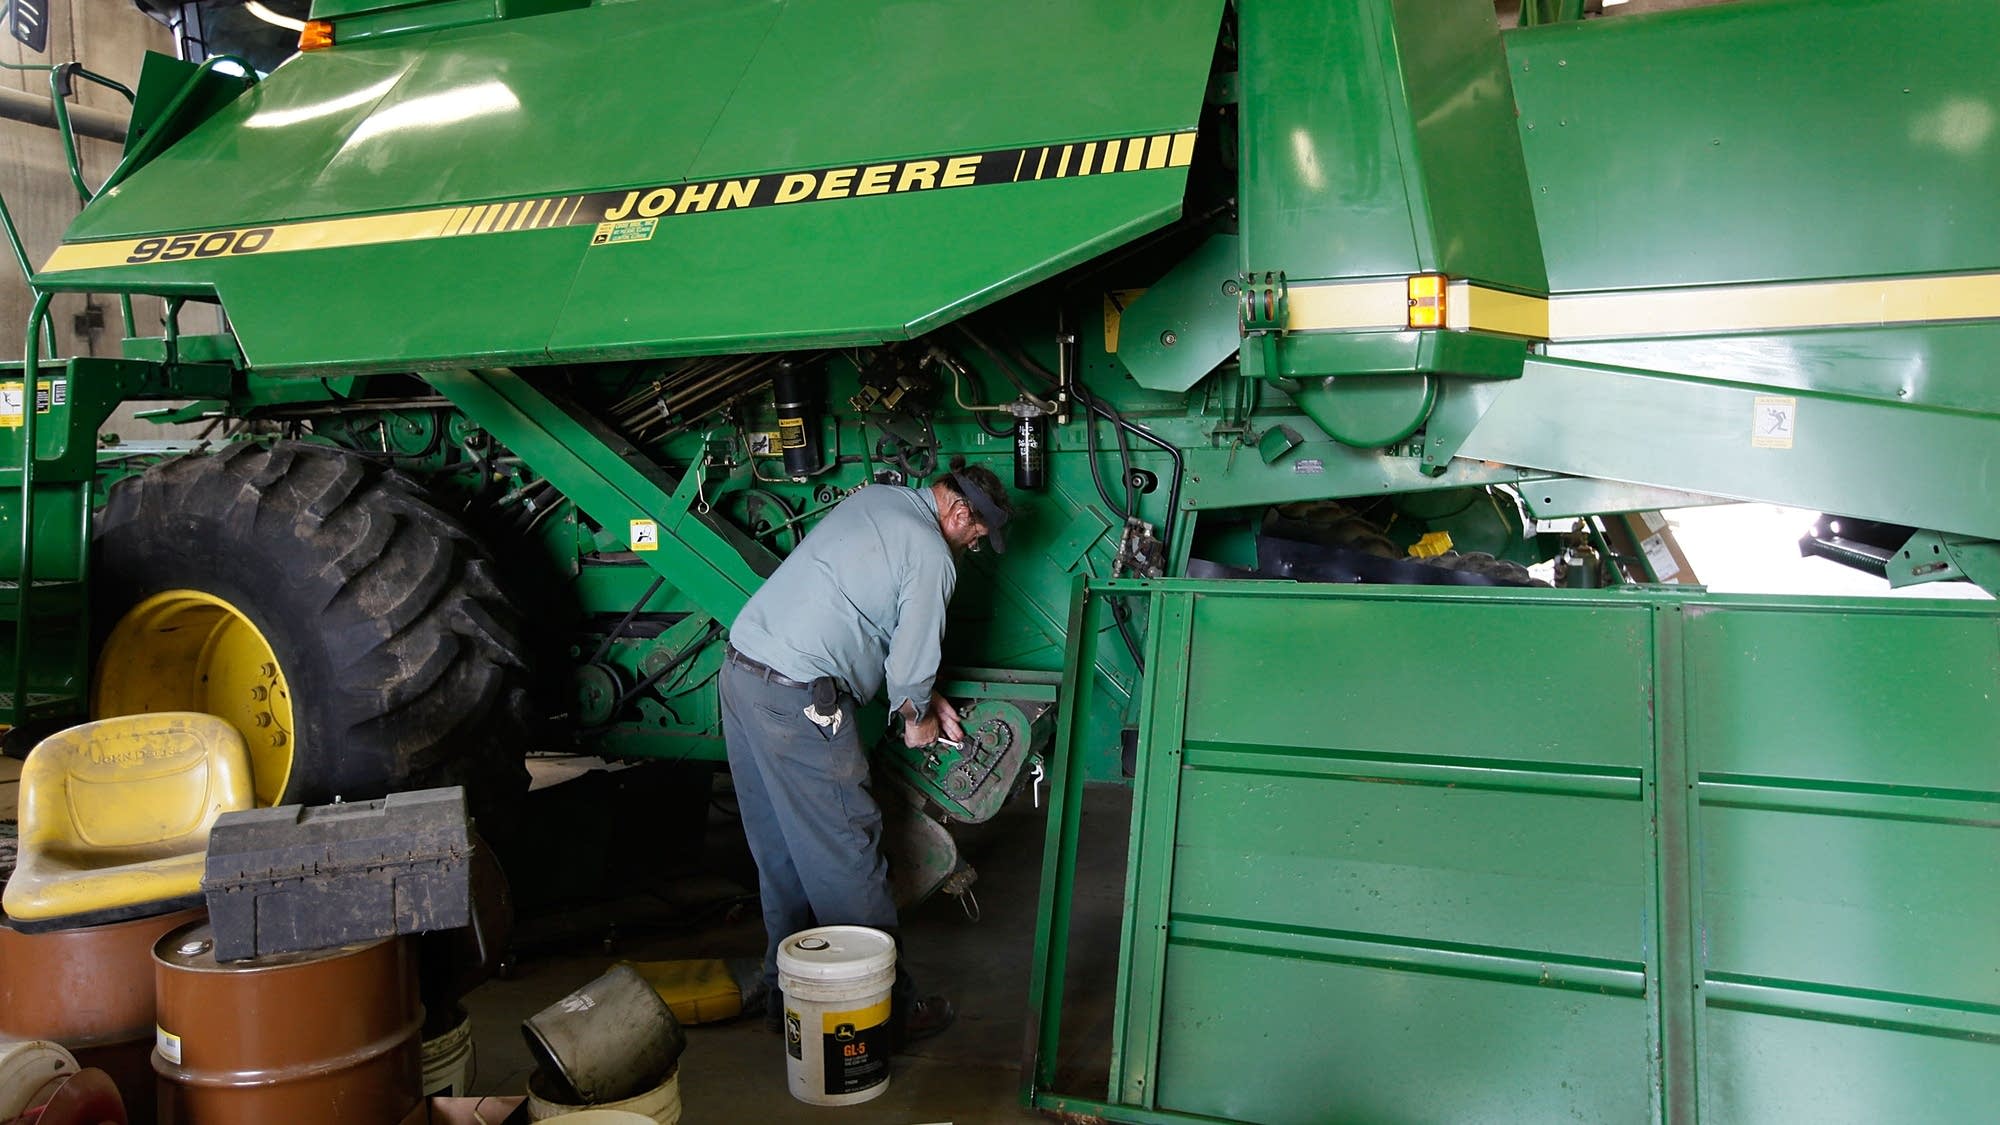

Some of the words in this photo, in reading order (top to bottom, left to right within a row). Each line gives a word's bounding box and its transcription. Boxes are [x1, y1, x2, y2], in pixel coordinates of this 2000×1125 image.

[605, 179, 760, 221] JOHN
[774, 155, 983, 203] DEERE
[126, 229, 274, 263] 9500
